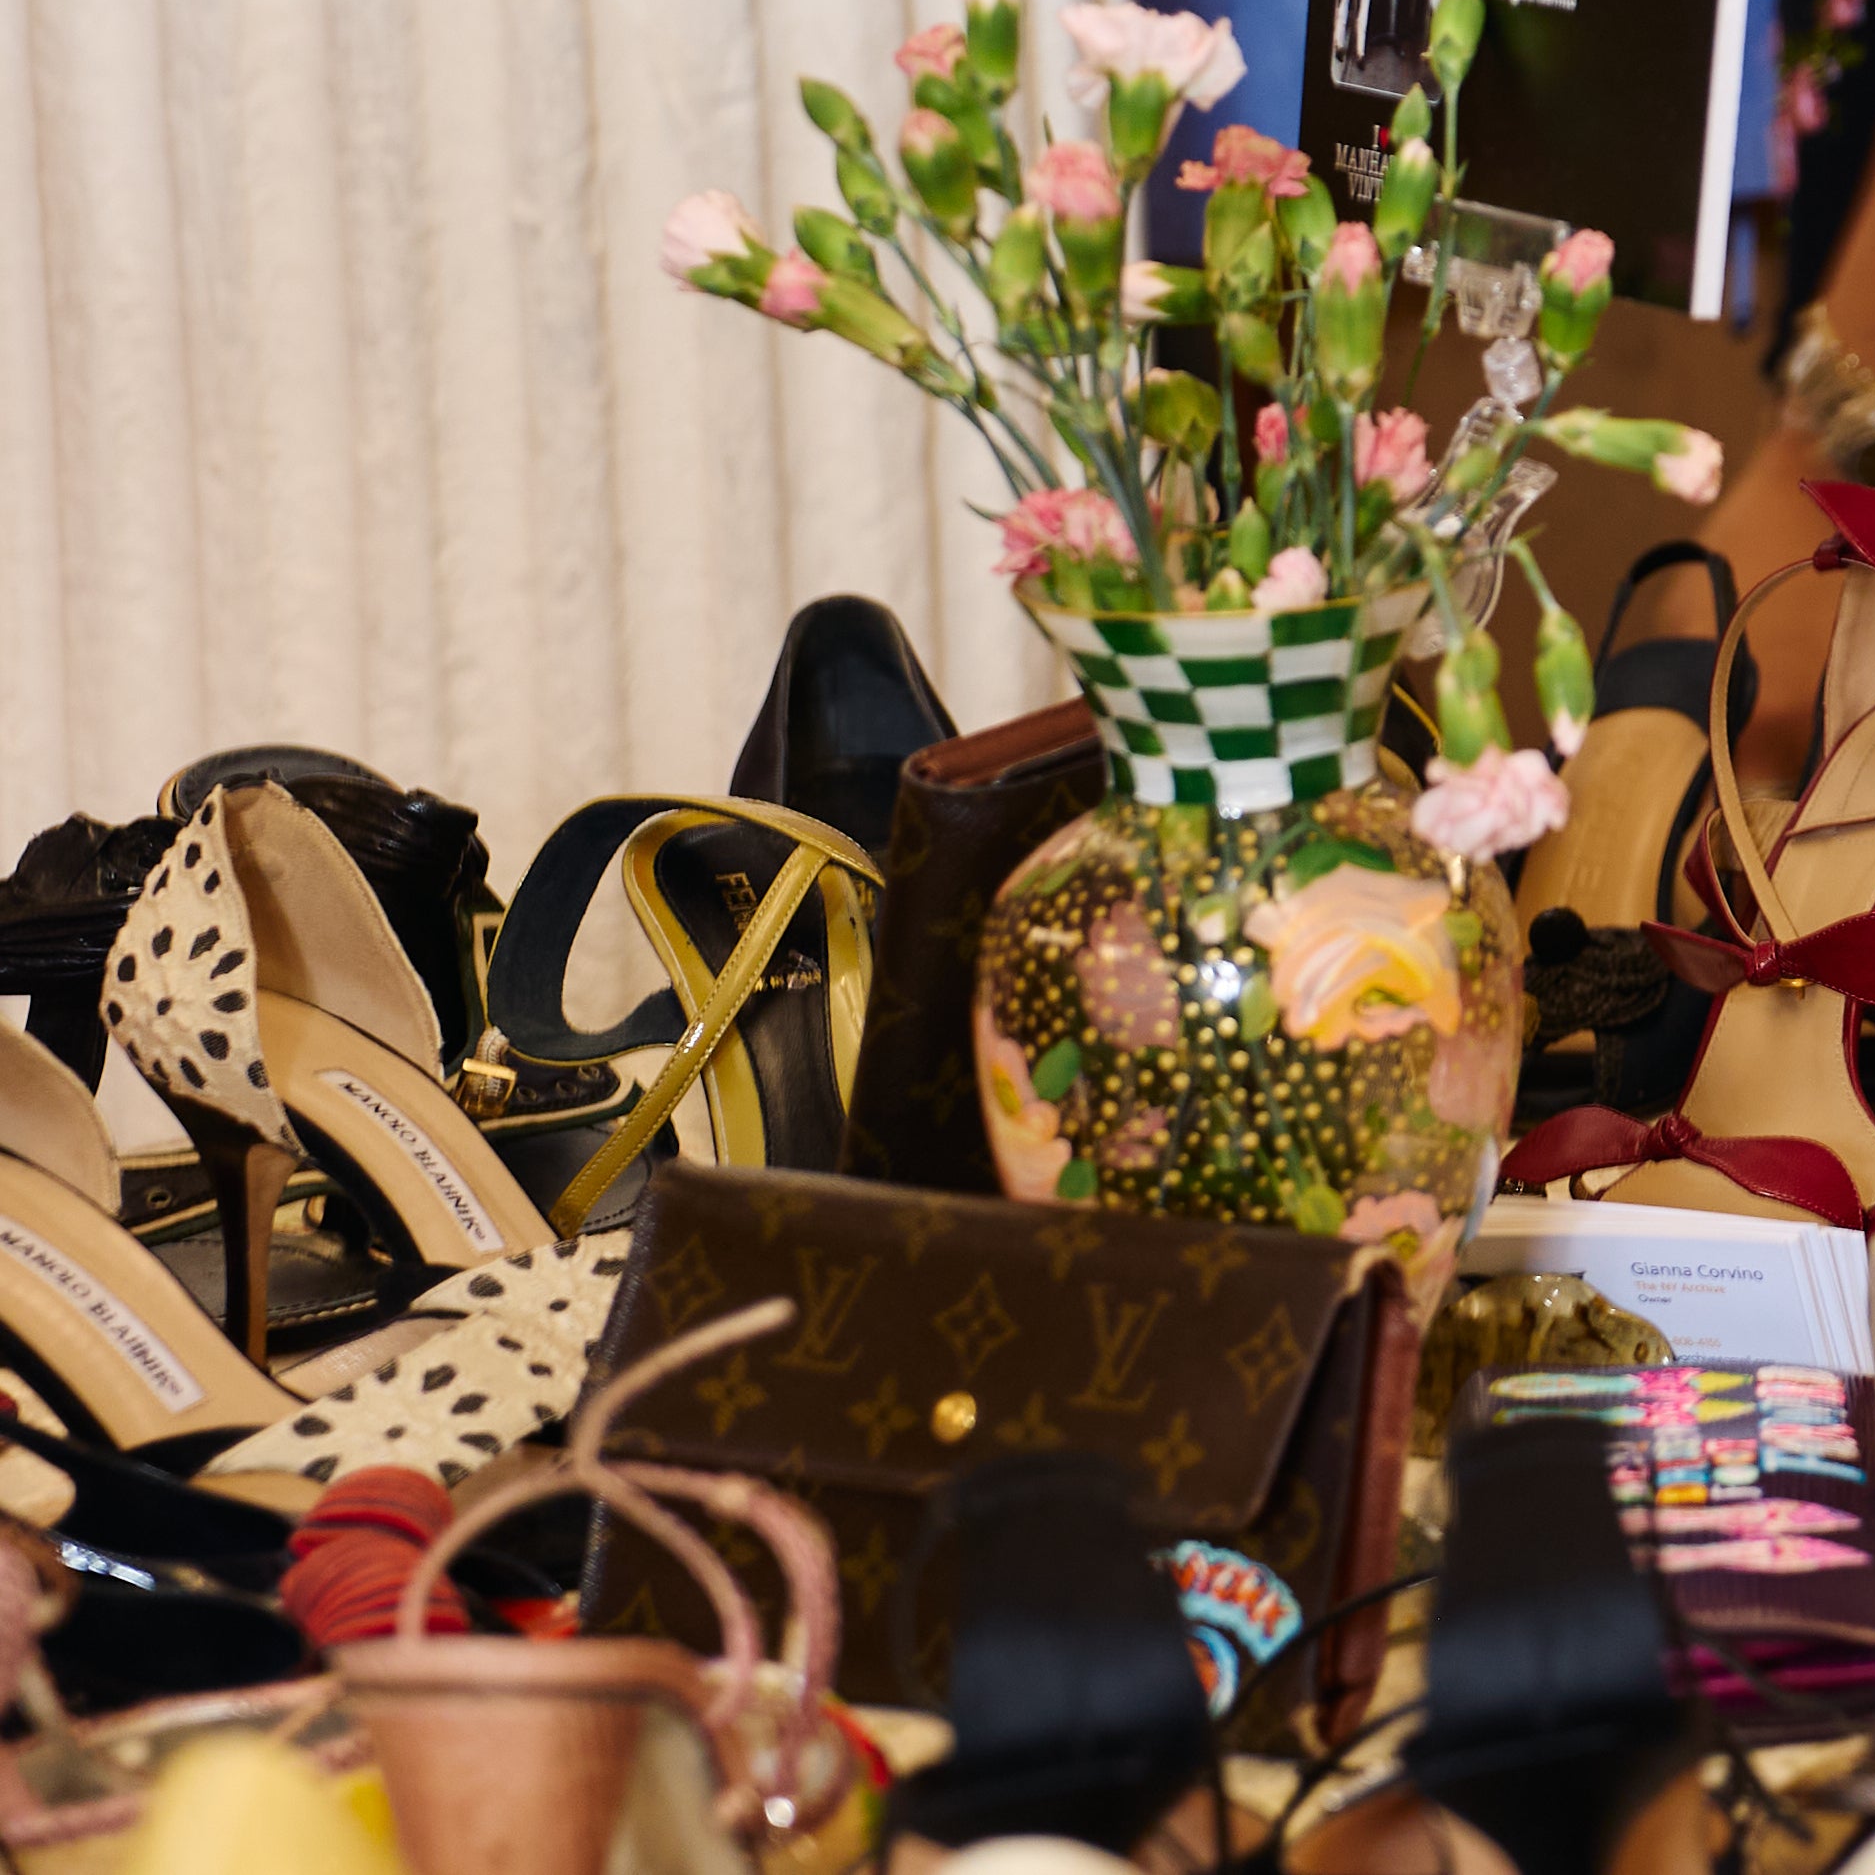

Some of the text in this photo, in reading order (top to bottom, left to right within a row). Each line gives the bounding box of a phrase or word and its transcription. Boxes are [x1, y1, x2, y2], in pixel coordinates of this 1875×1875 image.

[1334, 142, 1394, 176] MANHA
[338, 1081, 417, 1144] MANOLO
[1630, 1261, 1764, 1281] Gianna Corvino
